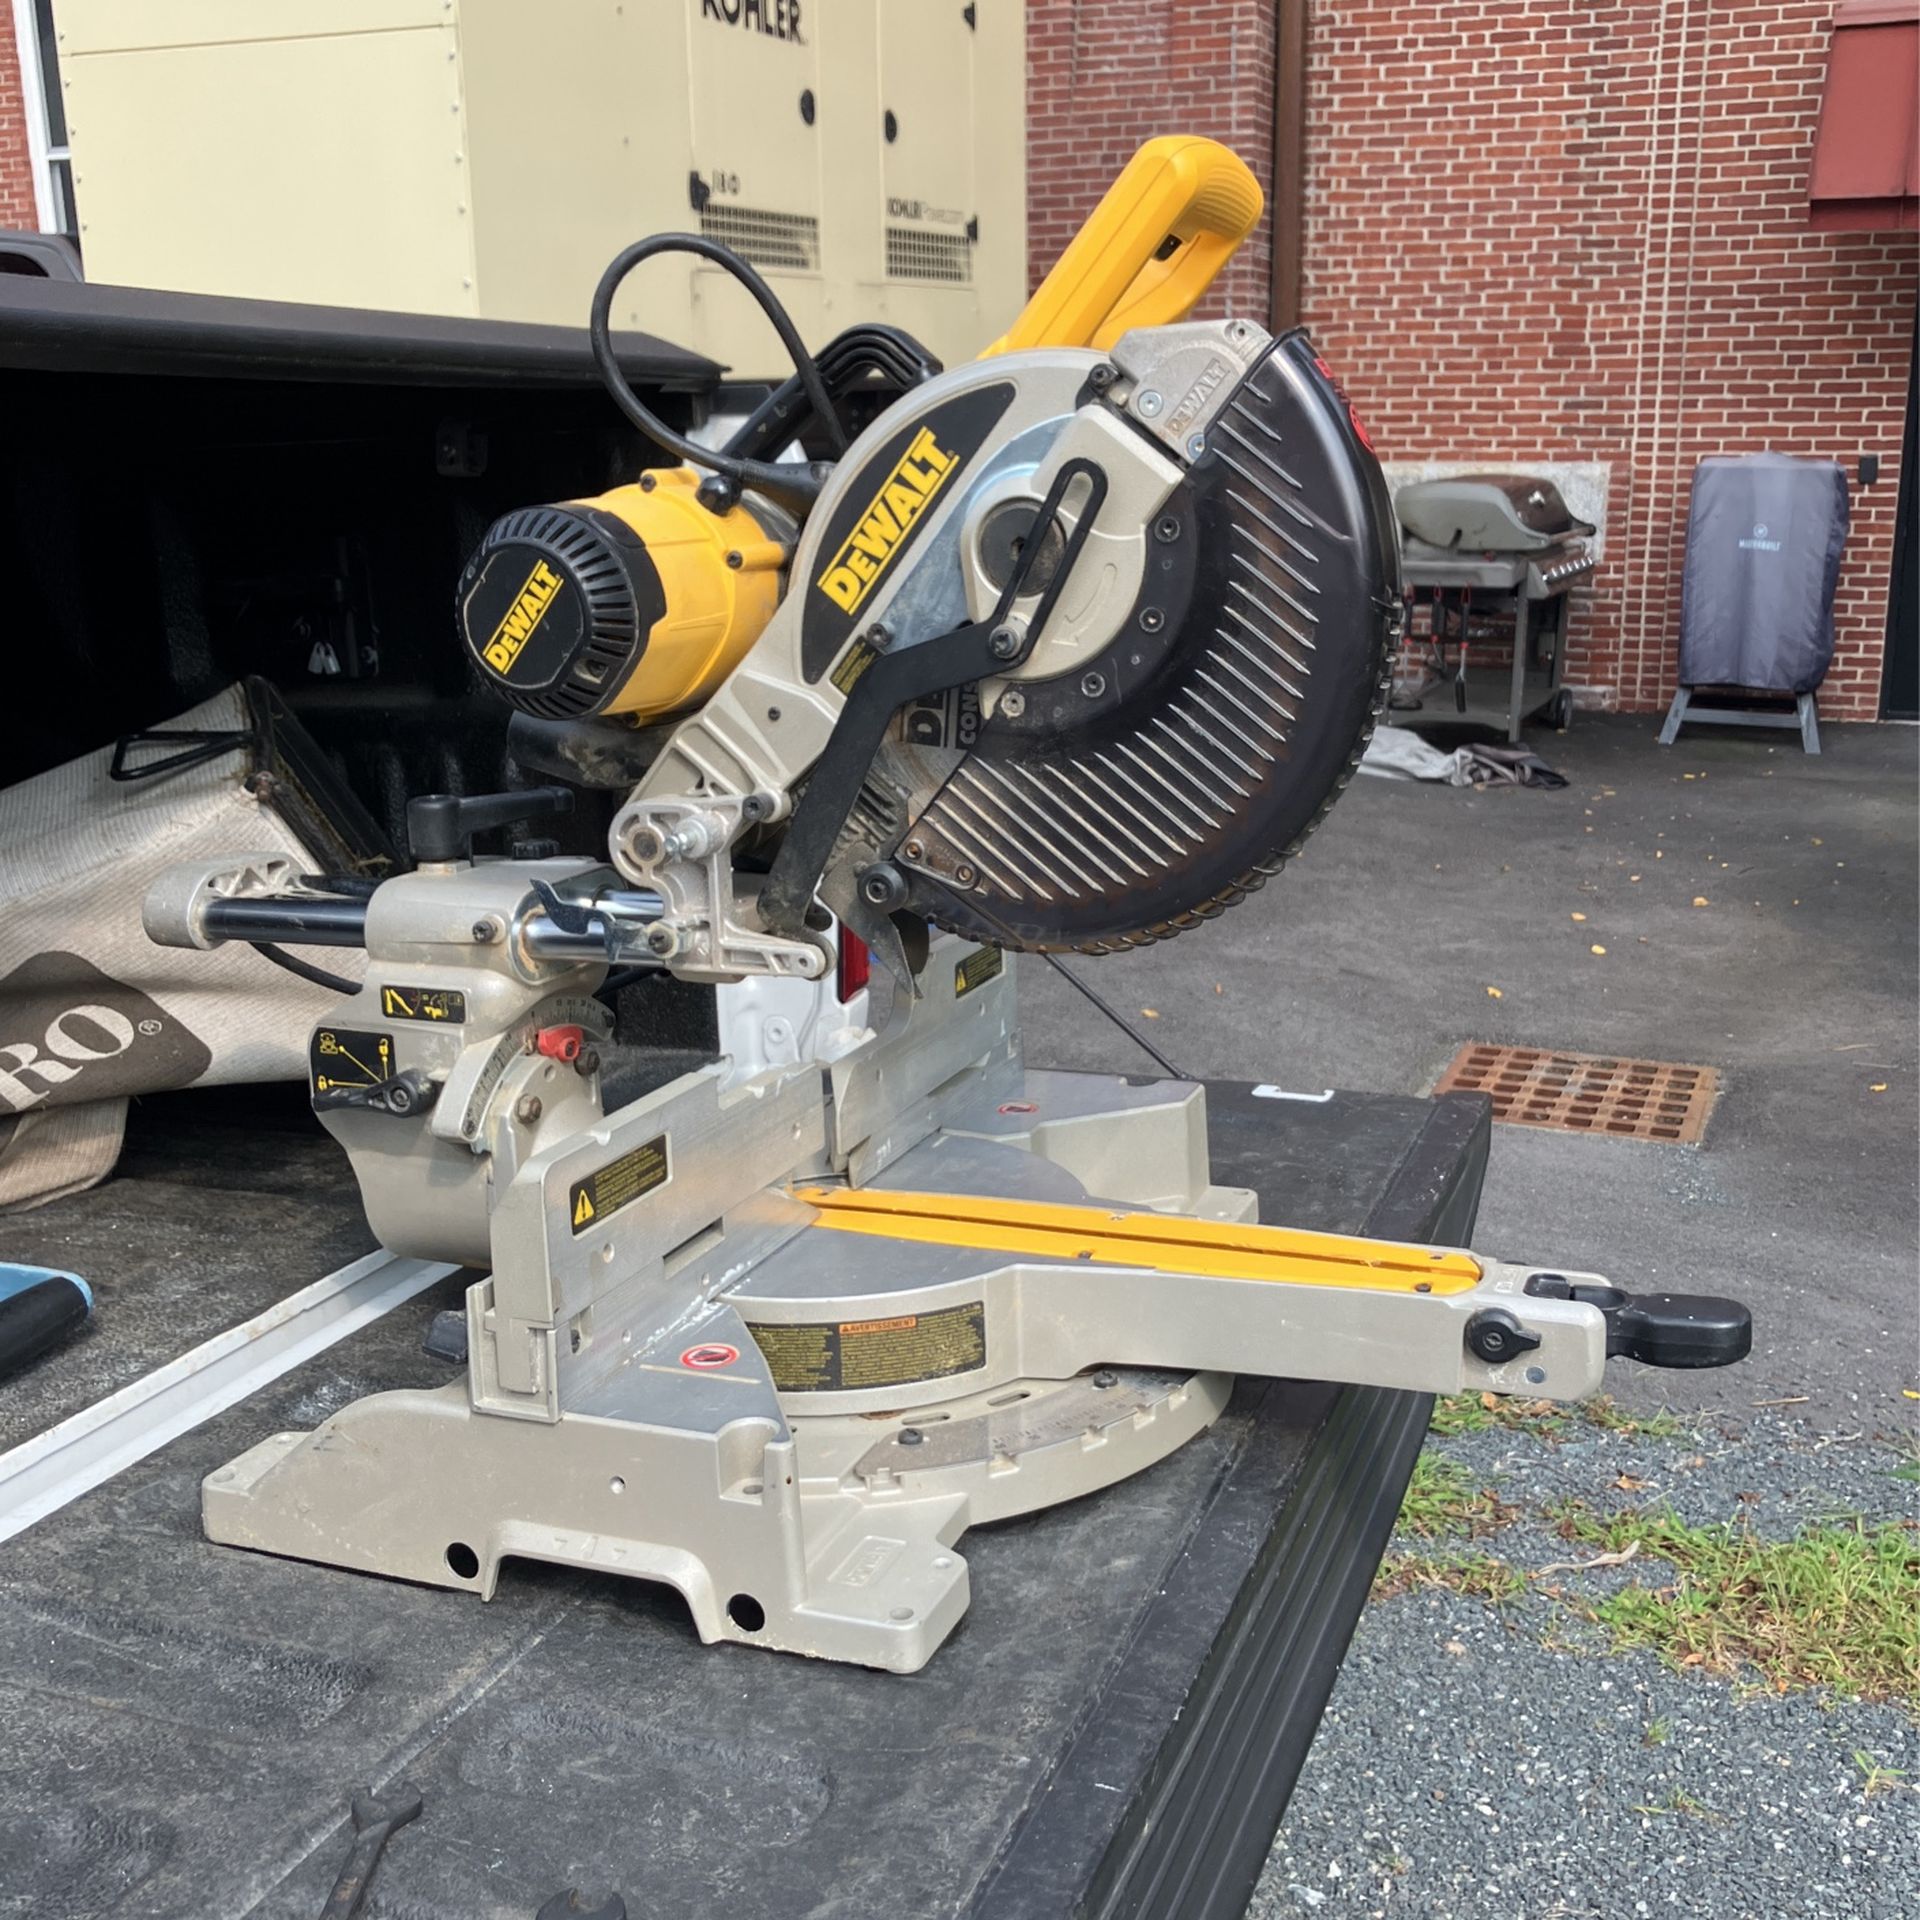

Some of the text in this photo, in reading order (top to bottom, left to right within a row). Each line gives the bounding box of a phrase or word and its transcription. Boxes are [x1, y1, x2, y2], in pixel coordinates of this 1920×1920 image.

[1166, 359, 1229, 437] DEWALT
[820, 427, 952, 613] DEWALT
[484, 561, 560, 672] DEWALT
